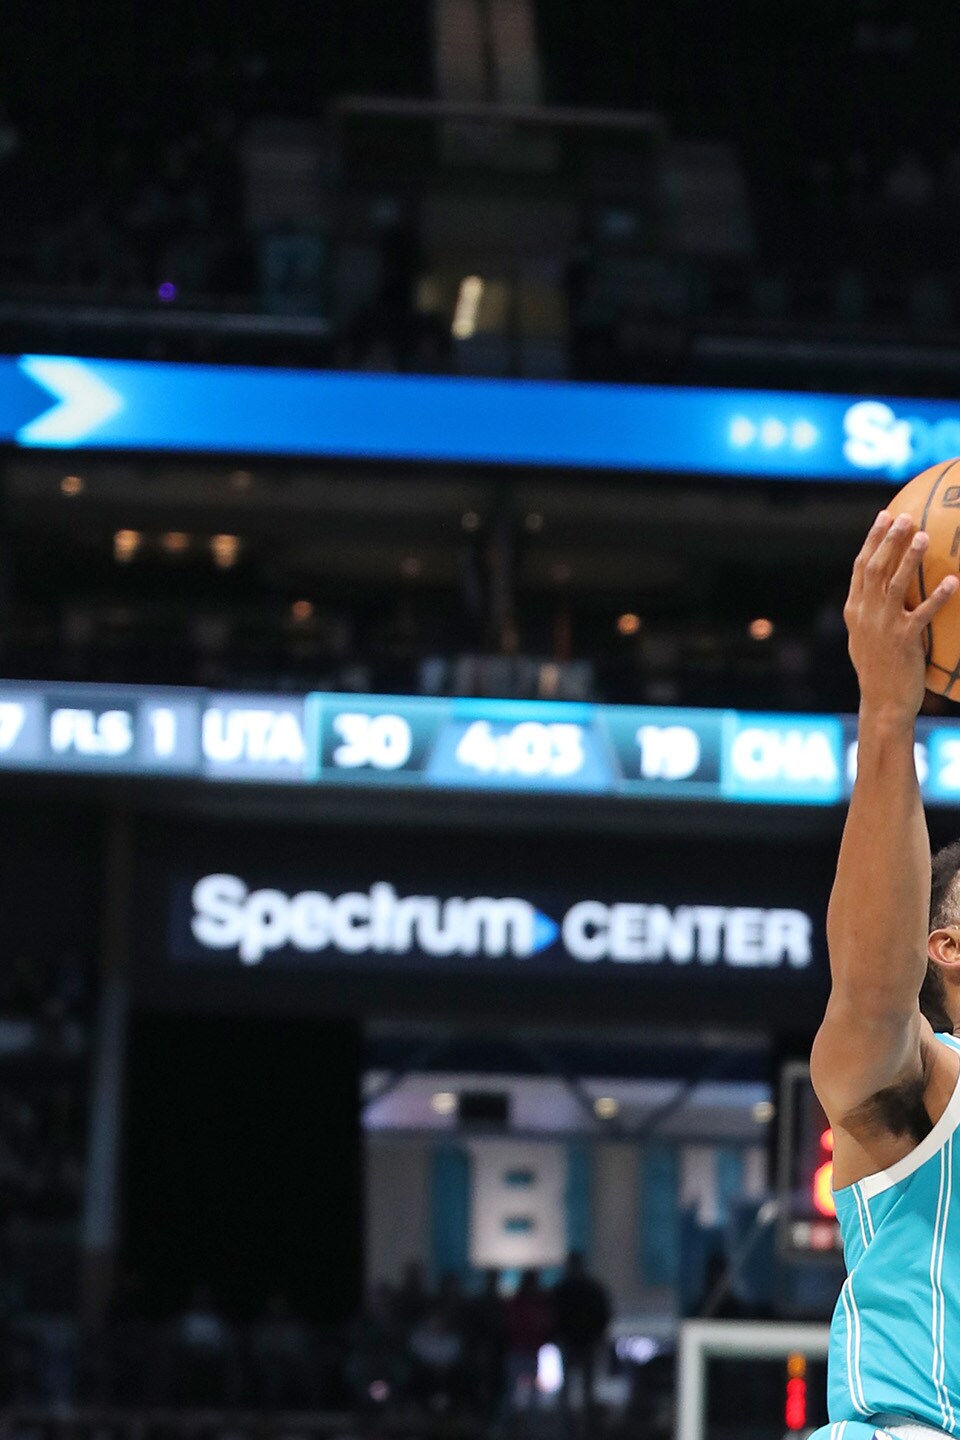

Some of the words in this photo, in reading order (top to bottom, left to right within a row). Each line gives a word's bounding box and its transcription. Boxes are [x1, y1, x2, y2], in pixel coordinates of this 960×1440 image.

[201, 707, 307, 763] UTA
[332, 712, 412, 770] 30
[731, 729, 840, 782] CHA
[190, 873, 536, 966] Spectrum
[561, 899, 813, 969] CENTER
